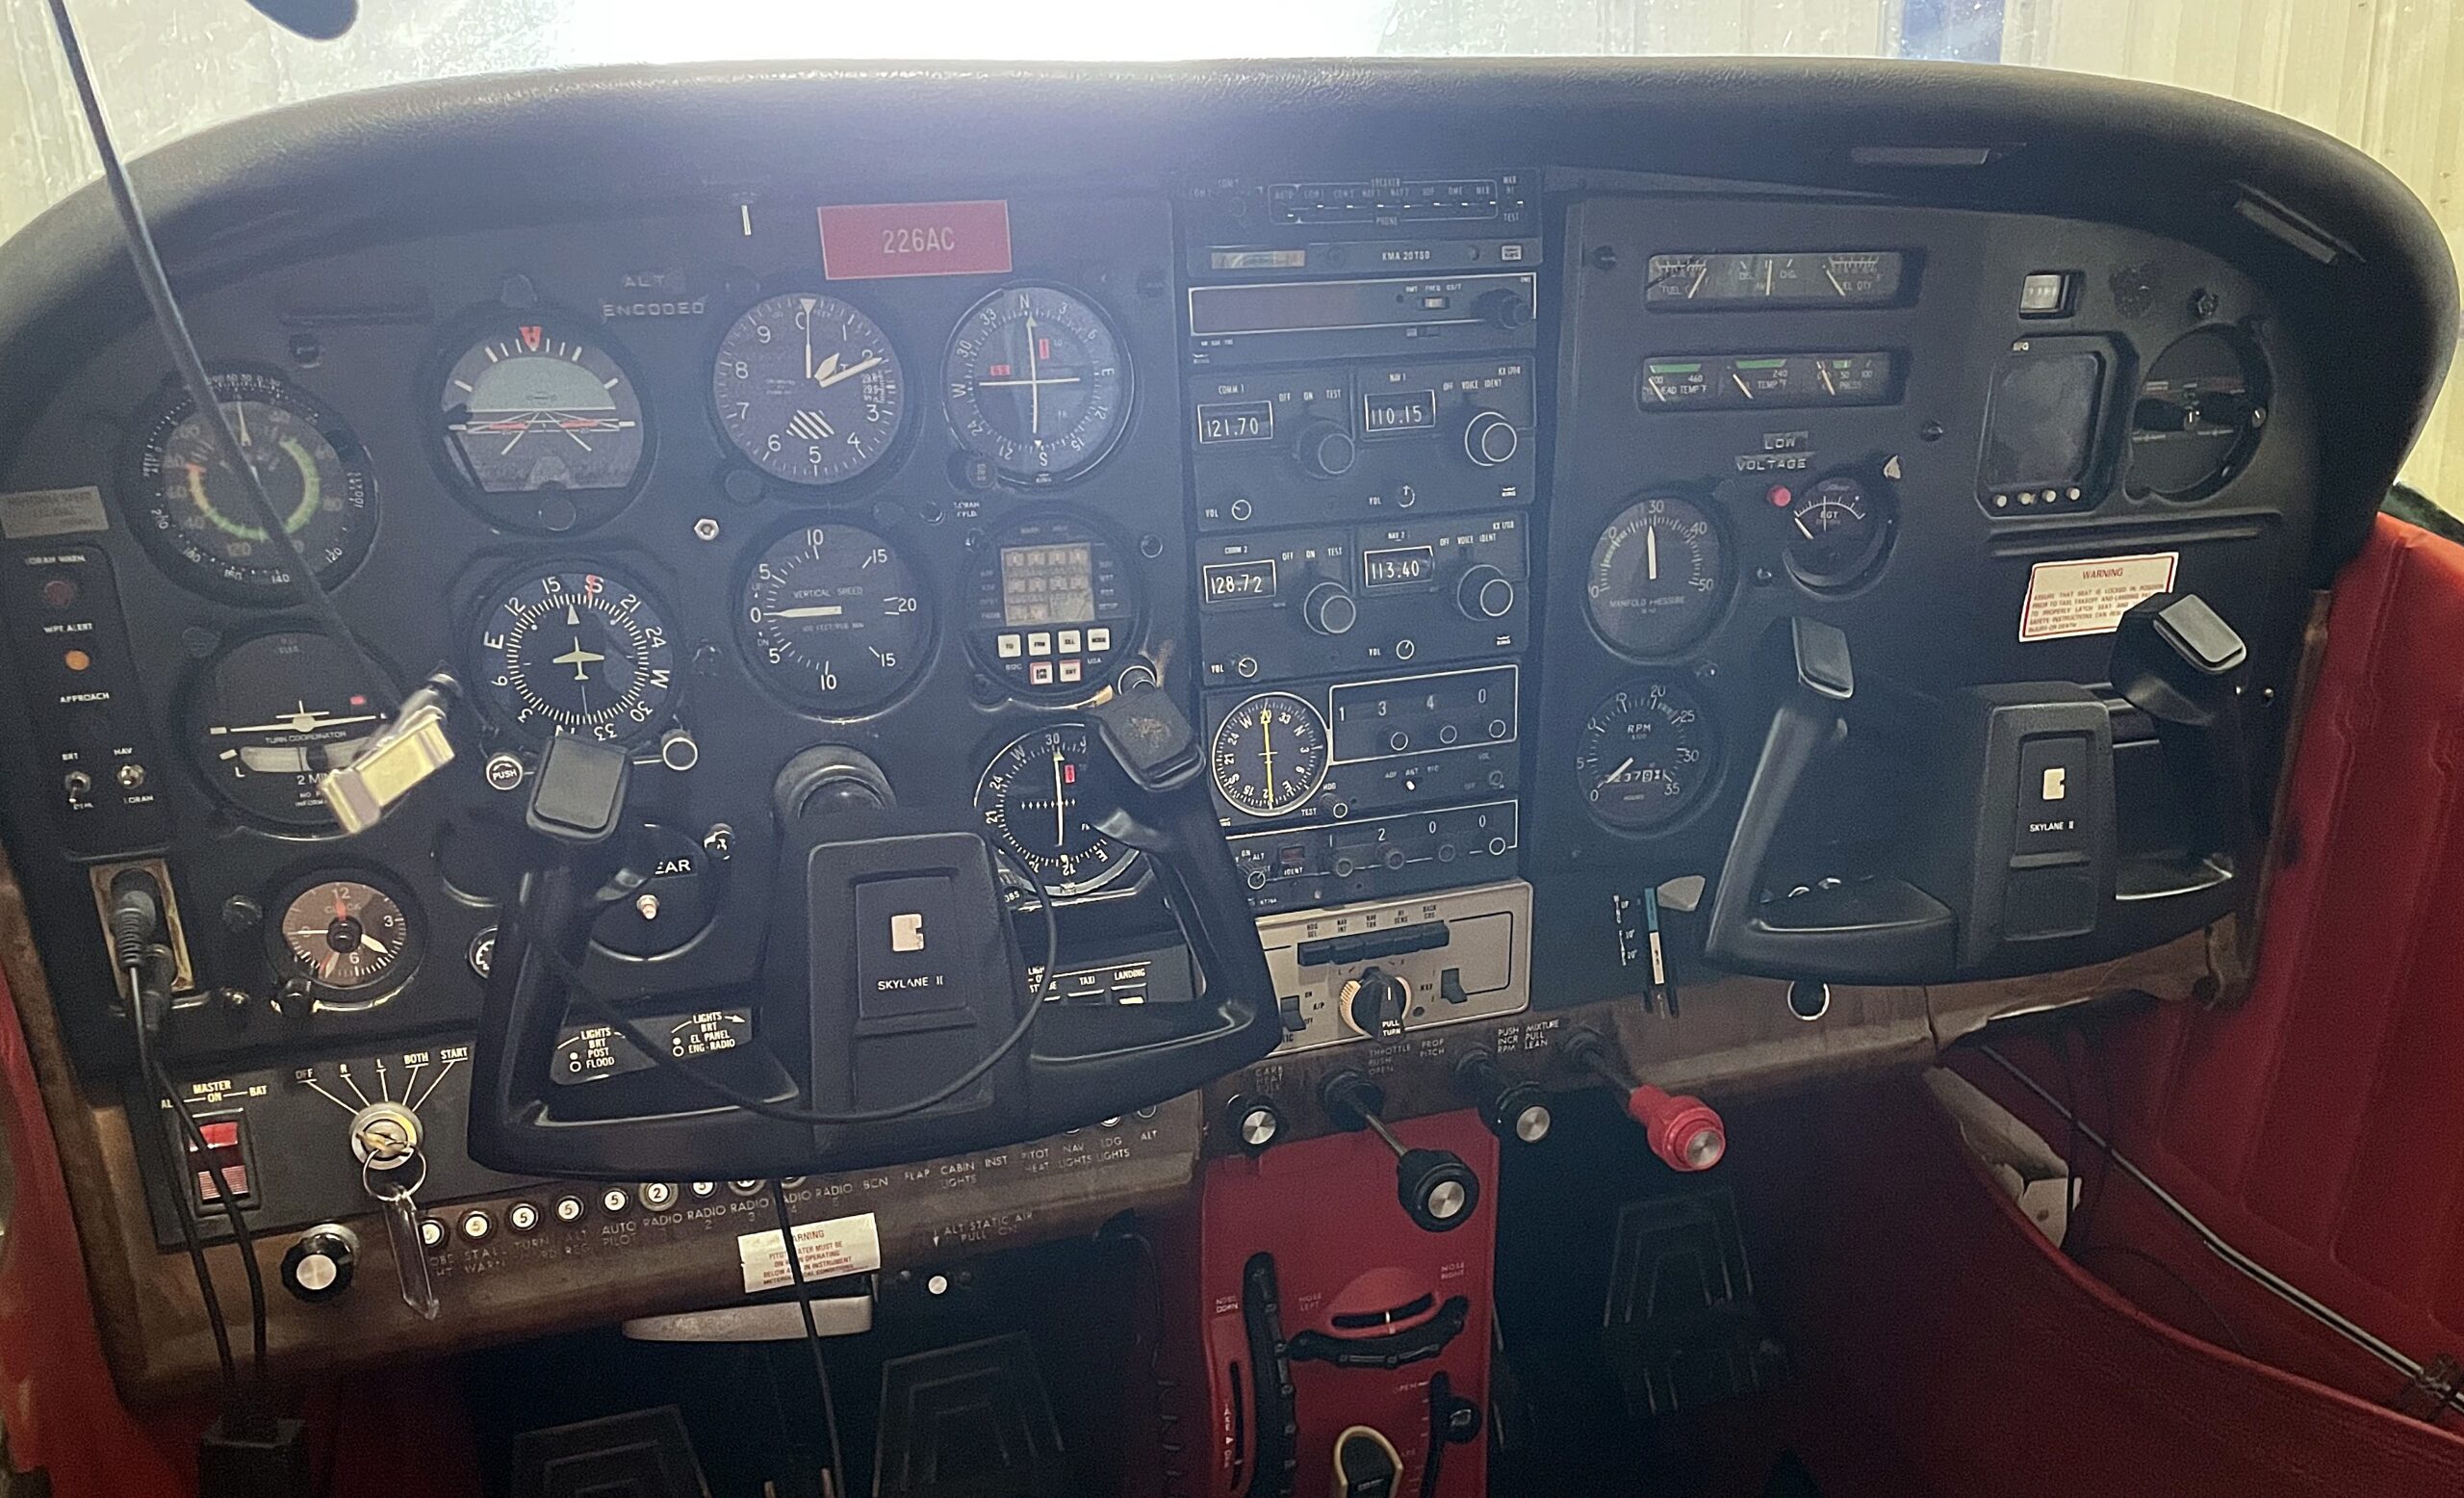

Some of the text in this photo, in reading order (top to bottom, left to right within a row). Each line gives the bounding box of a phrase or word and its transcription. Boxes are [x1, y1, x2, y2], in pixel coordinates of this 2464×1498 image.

[882, 226, 956, 254] 226AC
[1461, 380, 1478, 390] VOICE
[1278, 389, 1341, 402] OFF ON TEST
[1372, 404, 1423, 426] 110.15
[1207, 417, 1259, 438] 121.70
[847, 431, 860, 447] 4
[1764, 437, 1797, 451] LOW
[808, 446, 822, 464] 5
[1735, 457, 1808, 472] VOLTAGE
[1369, 497, 1382, 505] VOL
[1648, 500, 1665, 514] 30
[1205, 508, 1219, 518] VOL
[1689, 521, 1707, 535] 40
[807, 528, 825, 546] 10
[872, 548, 887, 564] 15
[1281, 547, 1343, 561] OFF ON TEST
[758, 563, 771, 581] 5
[1372, 559, 1419, 580] 113.40
[2082, 567, 2124, 580] WARNING
[542, 576, 561, 595] 15
[584, 574, 603, 594] S
[1211, 574, 1263, 594] 128.72
[1698, 578, 1713, 592] 50
[792, 585, 863, 599] VERTICAL SPEED
[504, 596, 526, 616] 12
[619, 593, 642, 613] 21
[898, 598, 917, 612] 20
[483, 631, 504, 650] E
[645, 626, 667, 649] 24
[768, 648, 781, 664] 5
[1369, 648, 1381, 657] VOL
[880, 653, 896, 668] 15
[1211, 664, 1224, 673] VOL
[650, 669, 671, 689] W
[820, 674, 837, 691] 10
[60, 691, 110, 704] APPROACH
[1650, 684, 1666, 698] 20
[517, 708, 533, 723] 3
[629, 701, 653, 723] 30
[1278, 711, 1292, 725] 33
[1680, 710, 1695, 723] 25
[593, 723, 618, 742] 33
[1627, 723, 1652, 734] RPM
[265, 730, 347, 745] TURN COORDINATOR
[1045, 733, 1060, 746] 30
[1227, 733, 1240, 746] 24
[1682, 749, 1700, 762] 30
[1577, 757, 1584, 770] 5
[492, 769, 518, 781] PUSH
[989, 774, 1004, 790] 24
[1589, 788, 1599, 802] 0
[1663, 782, 1681, 796] 35
[1300, 807, 1317, 816] TEST
[2029, 821, 2065, 833] SKYLANE
[1252, 852, 1265, 861] ALT
[383, 915, 394, 928] 3
[348, 952, 360, 965] 6
[1079, 975, 1095, 986] TAXI
[1114, 968, 1146, 981] LANDING
[877, 975, 929, 991] SKYLANE
[693, 1011, 723, 1024] LIGHTS
[1381, 1020, 1400, 1029] PULL
[700, 1021, 718, 1033] BRT
[1382, 1027, 1401, 1037] TURN
[1497, 1026, 1520, 1038] PUSH
[1526, 1019, 1560, 1032] MIXTURE
[580, 1027, 612, 1041] LIGHTS
[690, 1030, 731, 1044] EL PANEL
[1497, 1035, 1519, 1046] INCR
[1525, 1030, 1545, 1042] PULL
[589, 1039, 606, 1049] BRT
[1497, 1044, 1517, 1053] RPM
[1525, 1039, 1549, 1050] LEAN
[403, 1051, 429, 1066] BOTH
[440, 1046, 469, 1060] START
[587, 1046, 609, 1058] POST
[1420, 1046, 1445, 1058] PITCH
[339, 1063, 348, 1074] R
[375, 1058, 384, 1070] L
[585, 1056, 615, 1069] FLOOD
[295, 1068, 314, 1080] OFF
[192, 1079, 232, 1095] MASTER
[248, 1085, 268, 1098] BAT
[207, 1091, 222, 1103] ON
[1140, 1129, 1158, 1142] ALT
[1063, 1142, 1085, 1153] NAV
[984, 1154, 1009, 1168] INST
[1059, 1154, 1092, 1169] LIGHTS
[1096, 1149, 1131, 1162] LIGHTS
[939, 1160, 975, 1175] CABIN
[862, 1175, 889, 1191] BCN
[815, 1182, 855, 1199] RADIO
[686, 1204, 727, 1220] RADIO
[730, 1197, 770, 1213] RADIO
[643, 1212, 683, 1227] RADIO
[943, 1223, 963, 1236] ALT
[969, 1216, 1011, 1231] STATIC
[602, 1220, 636, 1236] AUTO
[793, 1228, 825, 1243] ARNING
